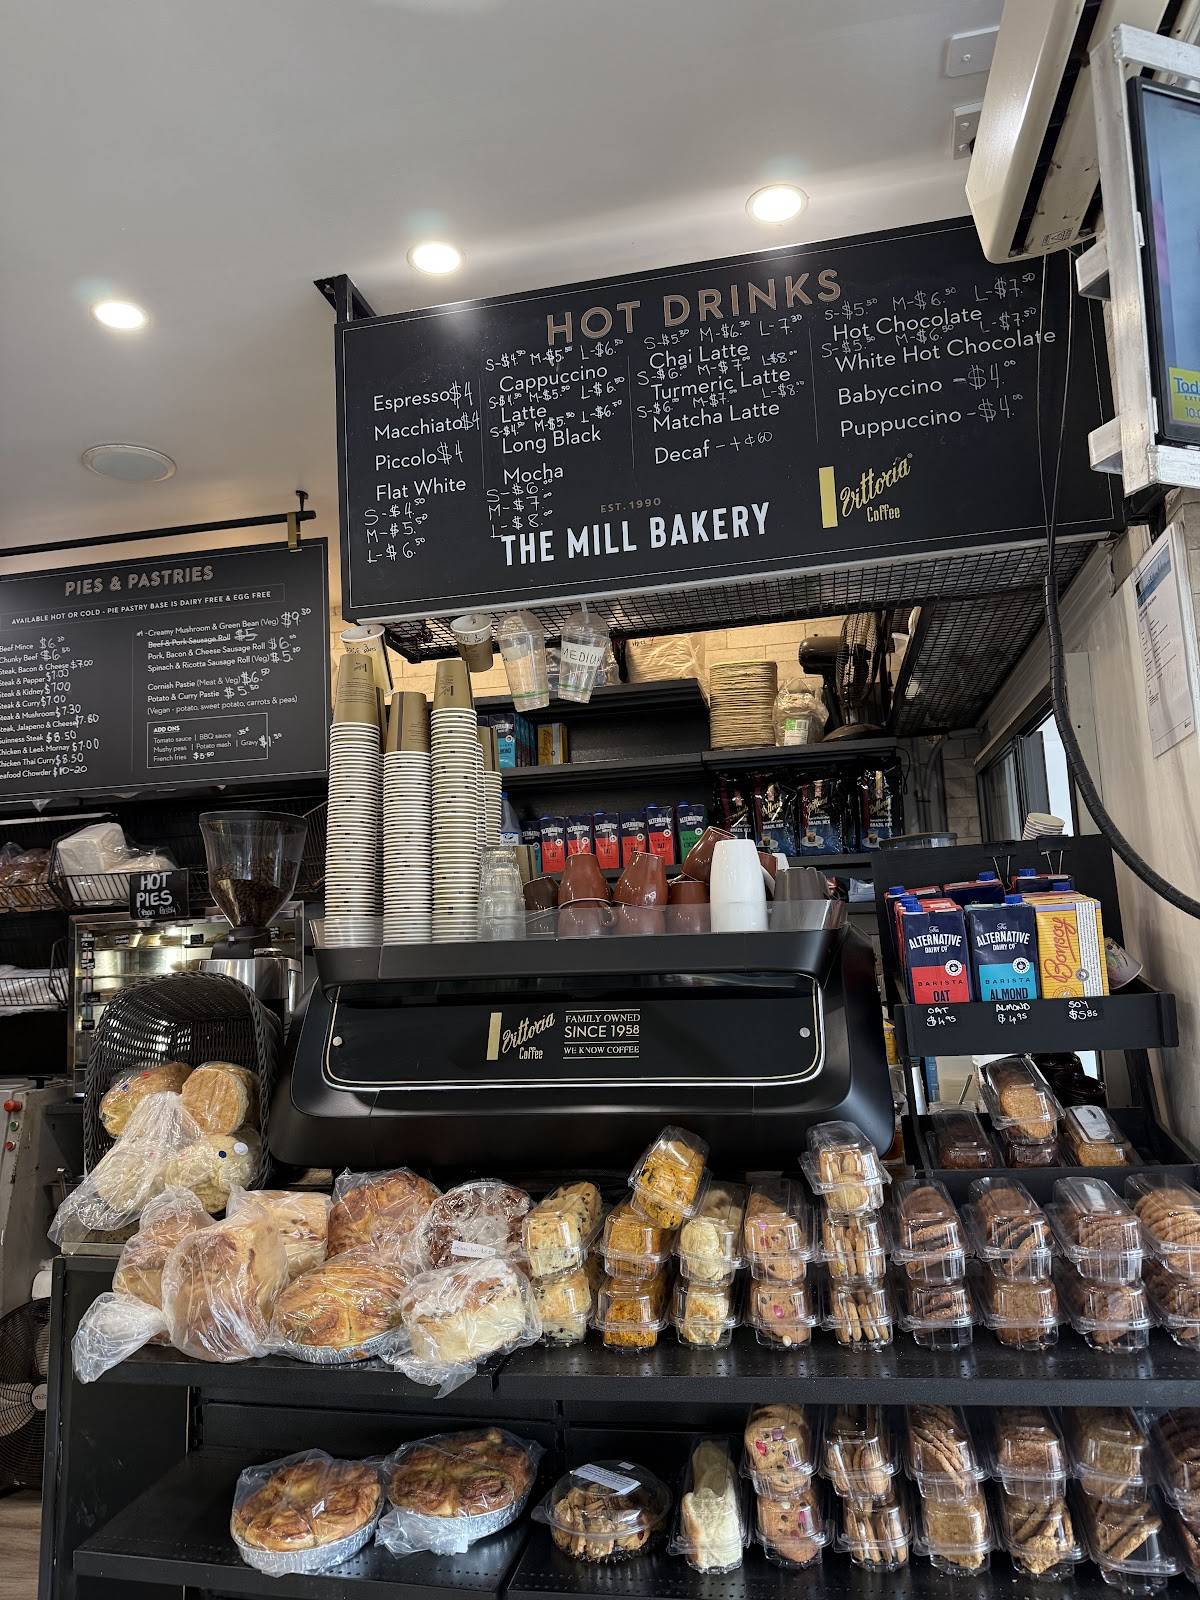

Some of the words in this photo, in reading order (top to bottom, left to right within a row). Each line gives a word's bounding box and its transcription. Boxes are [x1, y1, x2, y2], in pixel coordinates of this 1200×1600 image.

[547, 300, 641, 345] HOT
[663, 269, 841, 327] DRINKS
[833, 323, 870, 342] Hot
[876, 307, 983, 335] Chocolate
[649, 349, 692, 370] Chai
[699, 344, 749, 363] Latte
[834, 352, 896, 373] White
[903, 345, 941, 364] Hot
[947, 329, 1056, 357] Chocolate
[499, 366, 608, 393] Cappuccino
[650, 376, 734, 401] Turmeric
[740, 370, 791, 388] Latte
[374, 390, 450, 412] Espresso
[837, 379, 943, 406] Babyccino
[501, 406, 547, 424] Latte
[653, 408, 723, 433] Matcha
[729, 403, 780, 422] Latte
[840, 409, 962, 439] Puppuccino
[375, 418, 463, 441] Macchiato
[502, 437, 547, 454] Long
[552, 424, 602, 447] Black
[376, 448, 437, 471] Piccolo
[654, 439, 711, 465] Decaf
[503, 463, 564, 485] Mocha
[377, 483, 409, 501] Flat
[414, 477, 466, 496] White
[840, 457, 911, 518] Vittoria
[866, 503, 901, 522] Coffee
[501, 530, 555, 566] THE
[567, 520, 637, 559] MILL
[649, 502, 770, 549] BAKERY
[64, 577, 104, 597] PIES
[109, 575, 122, 592] &
[128, 565, 214, 589] PASTRIES
[11, 614, 49, 625] AVAILABLE
[50, 613, 66, 621] HOT
[67, 611, 78, 619] OR
[80, 609, 101, 618] COLD
[107, 606, 119, 614] PIE
[121, 604, 148, 613] PASTRY
[150, 601, 169, 610] BASE
[171, 600, 178, 608] IS
[180, 598, 202, 607] DAIRY
[204, 595, 223, 604] FREE
[233, 592, 250, 601] EGG
[251, 590, 272, 599] FREE
[175, 625, 211, 635] Mushroom
[219, 622, 241, 630] Green
[242, 620, 260, 628] Bean
[166, 651, 187, 659] Bacon
[195, 648, 221, 656] Cheese
[222, 645, 251, 655] Sausage
[252, 642, 266, 650] Roll
[147, 664, 174, 674] Spinach
[182, 660, 207, 669] Ricotta
[207, 658, 236, 668] Sausage
[237, 655, 251, 664] Roll
[147, 682, 174, 691] Cornish
[175, 680, 196, 689] Pastie
[147, 694, 170, 703] Potato
[178, 692, 198, 701] Curry
[199, 690, 220, 699] Pastie
[153, 726, 166, 734] ADD
[167, 725, 181, 733] ONS
[140, 871, 173, 891] HOT
[136, 889, 173, 908] PIES
[908, 933, 963, 950] ALTERNATIVE
[975, 930, 1031, 948] ALTERNATIVE
[992, 943, 1008, 951] DAIRY
[924, 946, 940, 954] DAIRY
[1043, 916, 1077, 983] Bonsoy
[985, 977, 1031, 985] BARISTA
[933, 989, 951, 1003] OAT
[990, 987, 1029, 1001] ALMOND
[927, 1006, 950, 1015] OAT
[995, 1002, 1031, 1013] ALMOND
[1068, 1000, 1089, 1009] SOY
[564, 1014, 602, 1024] FAMILY
[603, 1013, 641, 1023] OWNED
[501, 1012, 556, 1054] Vittoria
[564, 1025, 606, 1038] SINCE
[610, 1024, 640, 1038] 1958
[518, 1046, 543, 1060] Coffee
[563, 1046, 577, 1054] WE
[578, 1046, 605, 1054] KNOW
[606, 1045, 640, 1054] COFFEE
